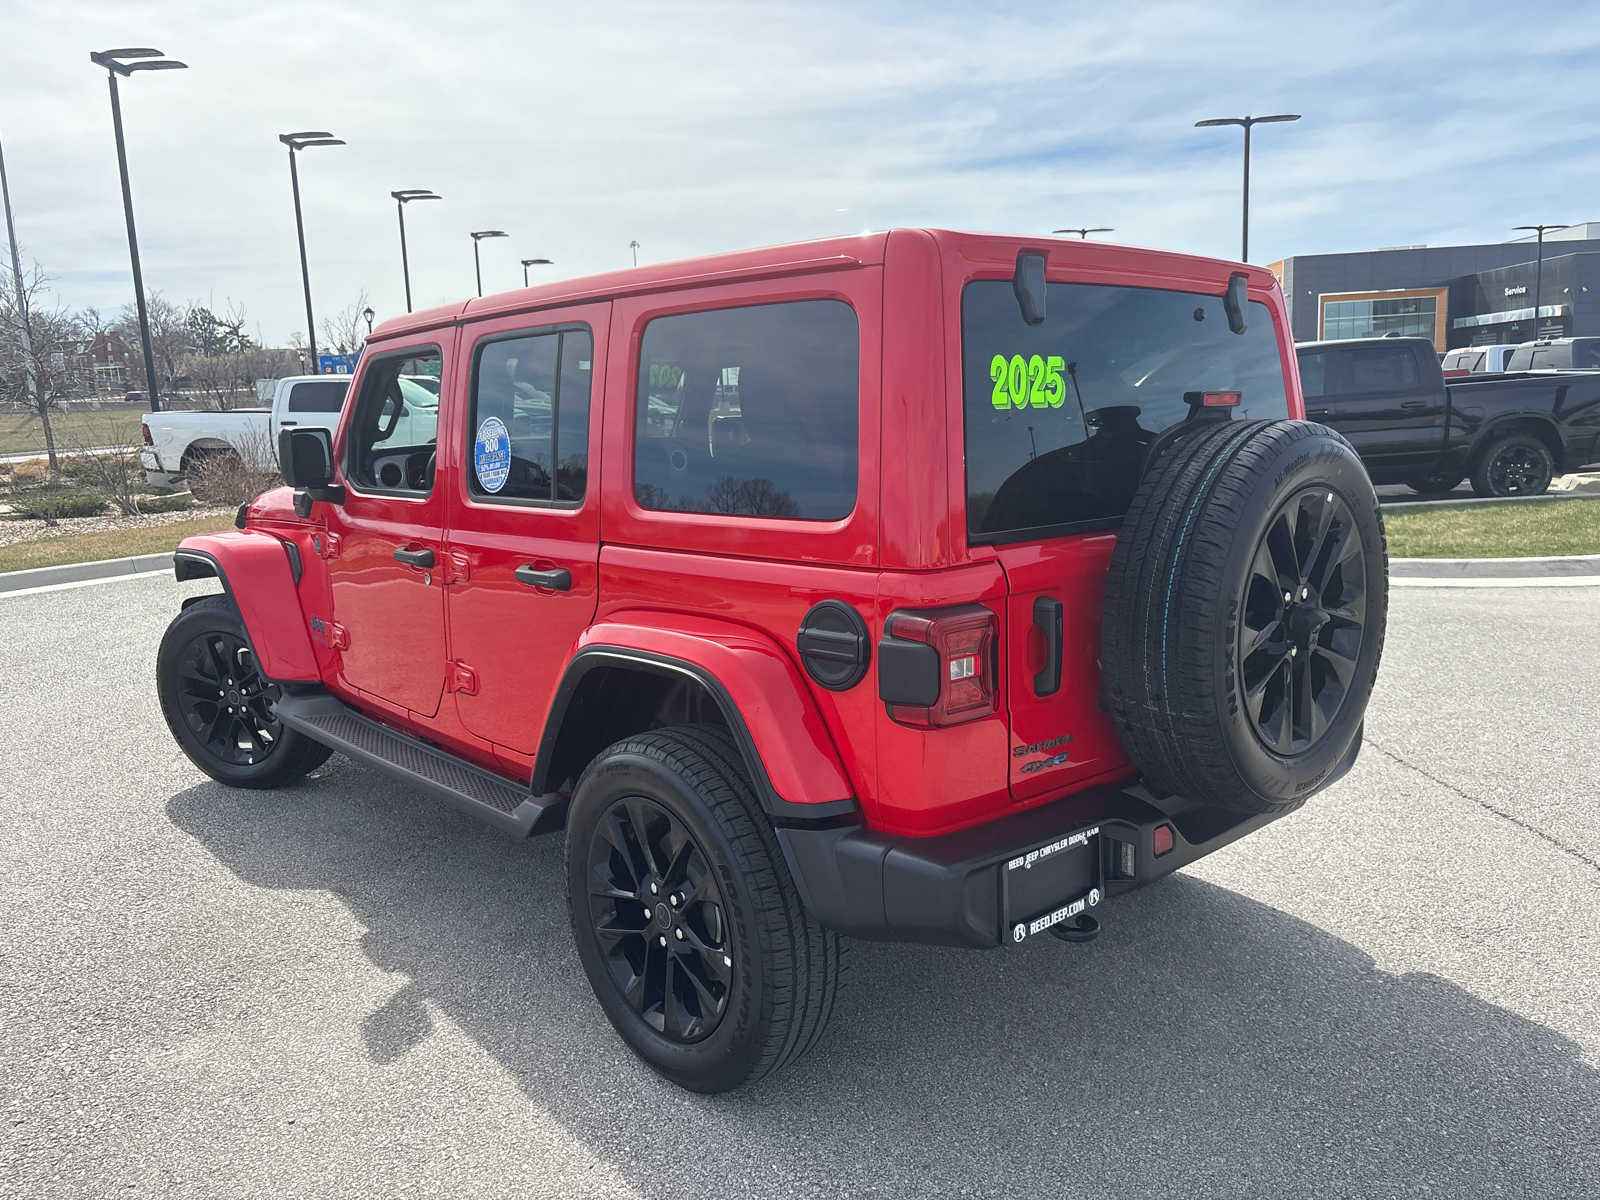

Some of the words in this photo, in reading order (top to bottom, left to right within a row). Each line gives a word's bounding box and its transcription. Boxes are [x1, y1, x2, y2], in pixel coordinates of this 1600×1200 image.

[1504, 286, 1527, 297] Service
[990, 354, 1066, 409] 2025
[485, 438, 498, 453] 800
[1274, 452, 1310, 489] All-Weather
[1225, 599, 1239, 717] NEXEN
[1013, 734, 1075, 757] SAHARA
[596, 763, 631, 779] All-Weather
[1008, 856, 1024, 870] REED
[1025, 851, 1039, 864] JEEP
[1039, 839, 1068, 858] CHRYSLER
[1068, 833, 1086, 846] DODGE
[1087, 827, 1099, 838] RAM
[1030, 899, 1085, 935] REEDJEEP.COM
